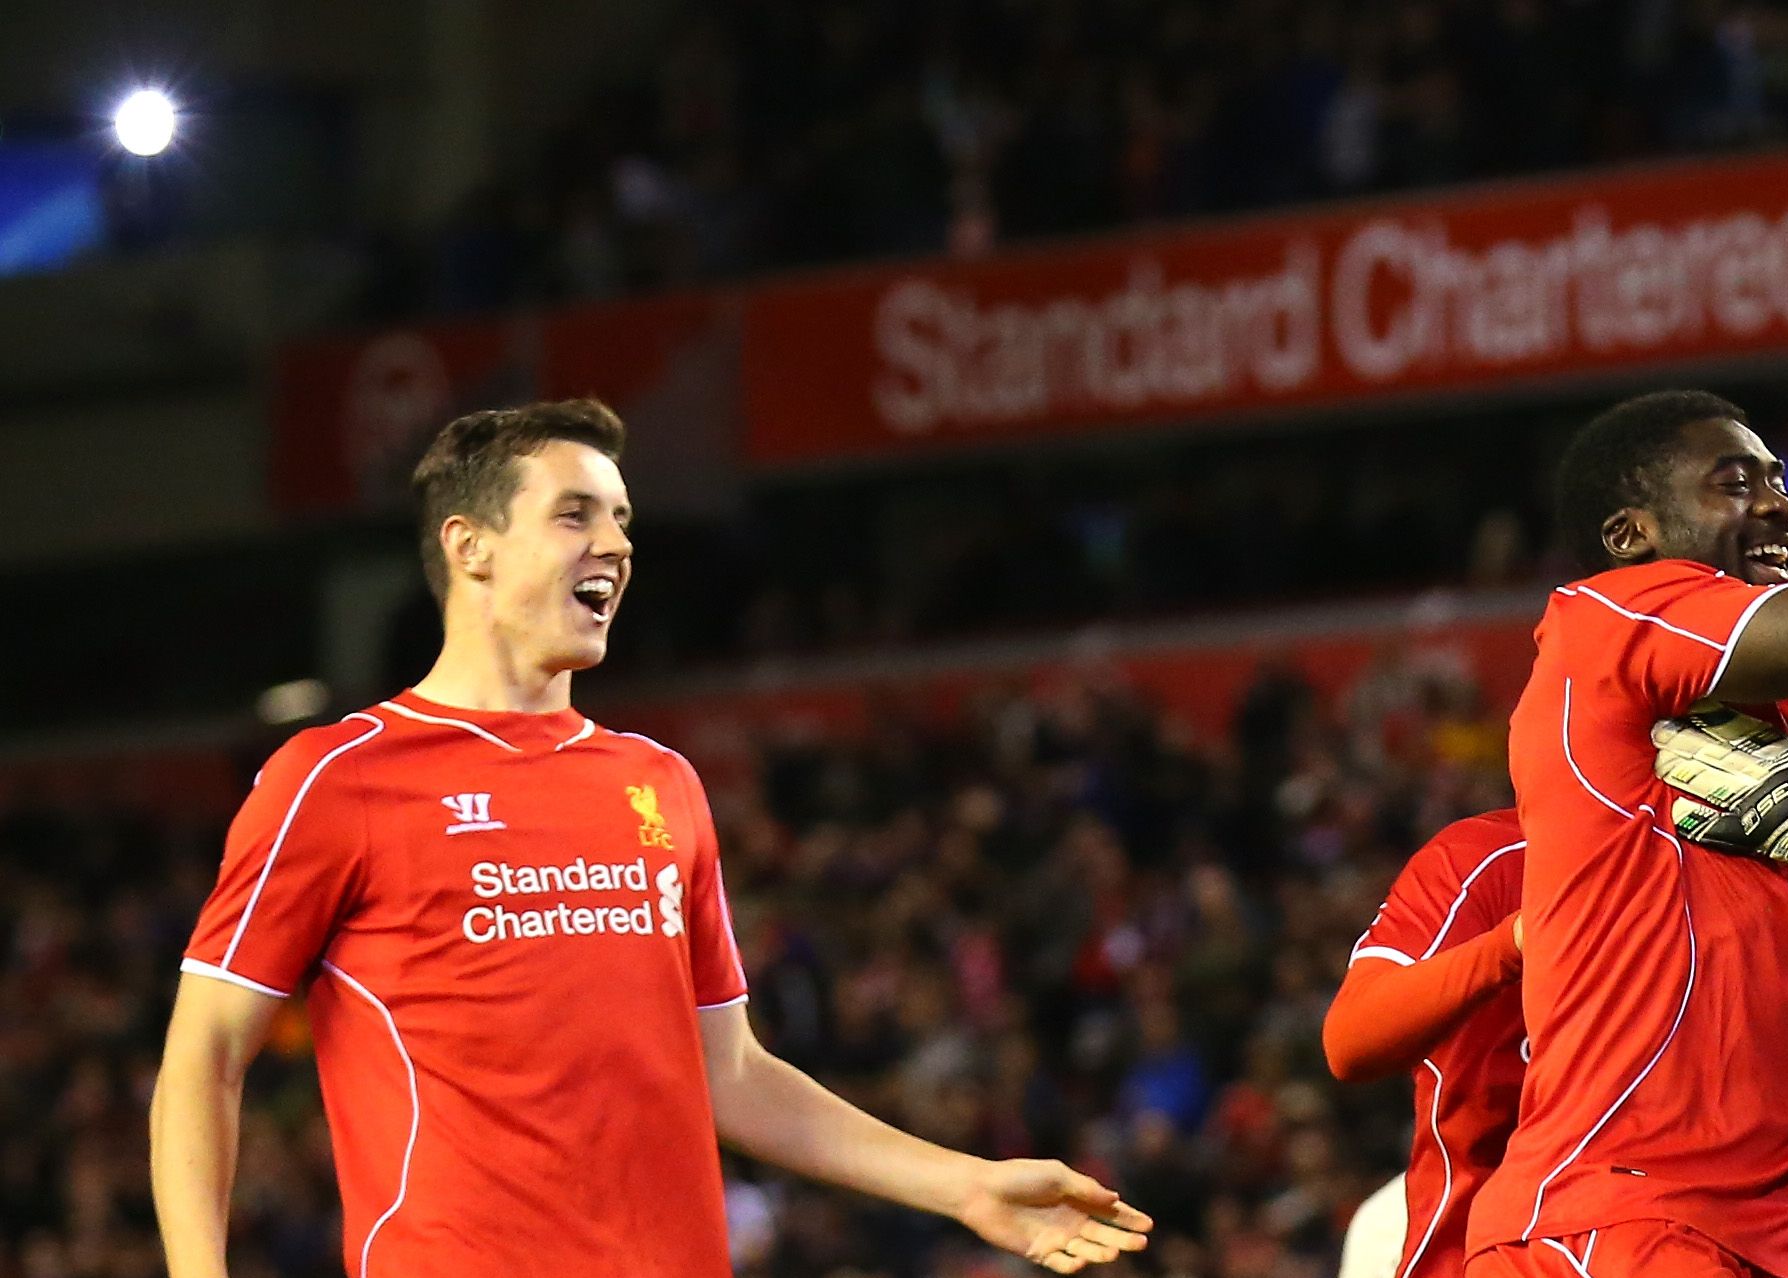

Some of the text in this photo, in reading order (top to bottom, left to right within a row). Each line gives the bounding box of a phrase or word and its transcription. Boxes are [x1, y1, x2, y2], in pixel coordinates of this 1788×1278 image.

[873, 237, 1322, 435] Standard
[471, 857, 648, 899] Standard
[462, 900, 654, 944] Chartered
